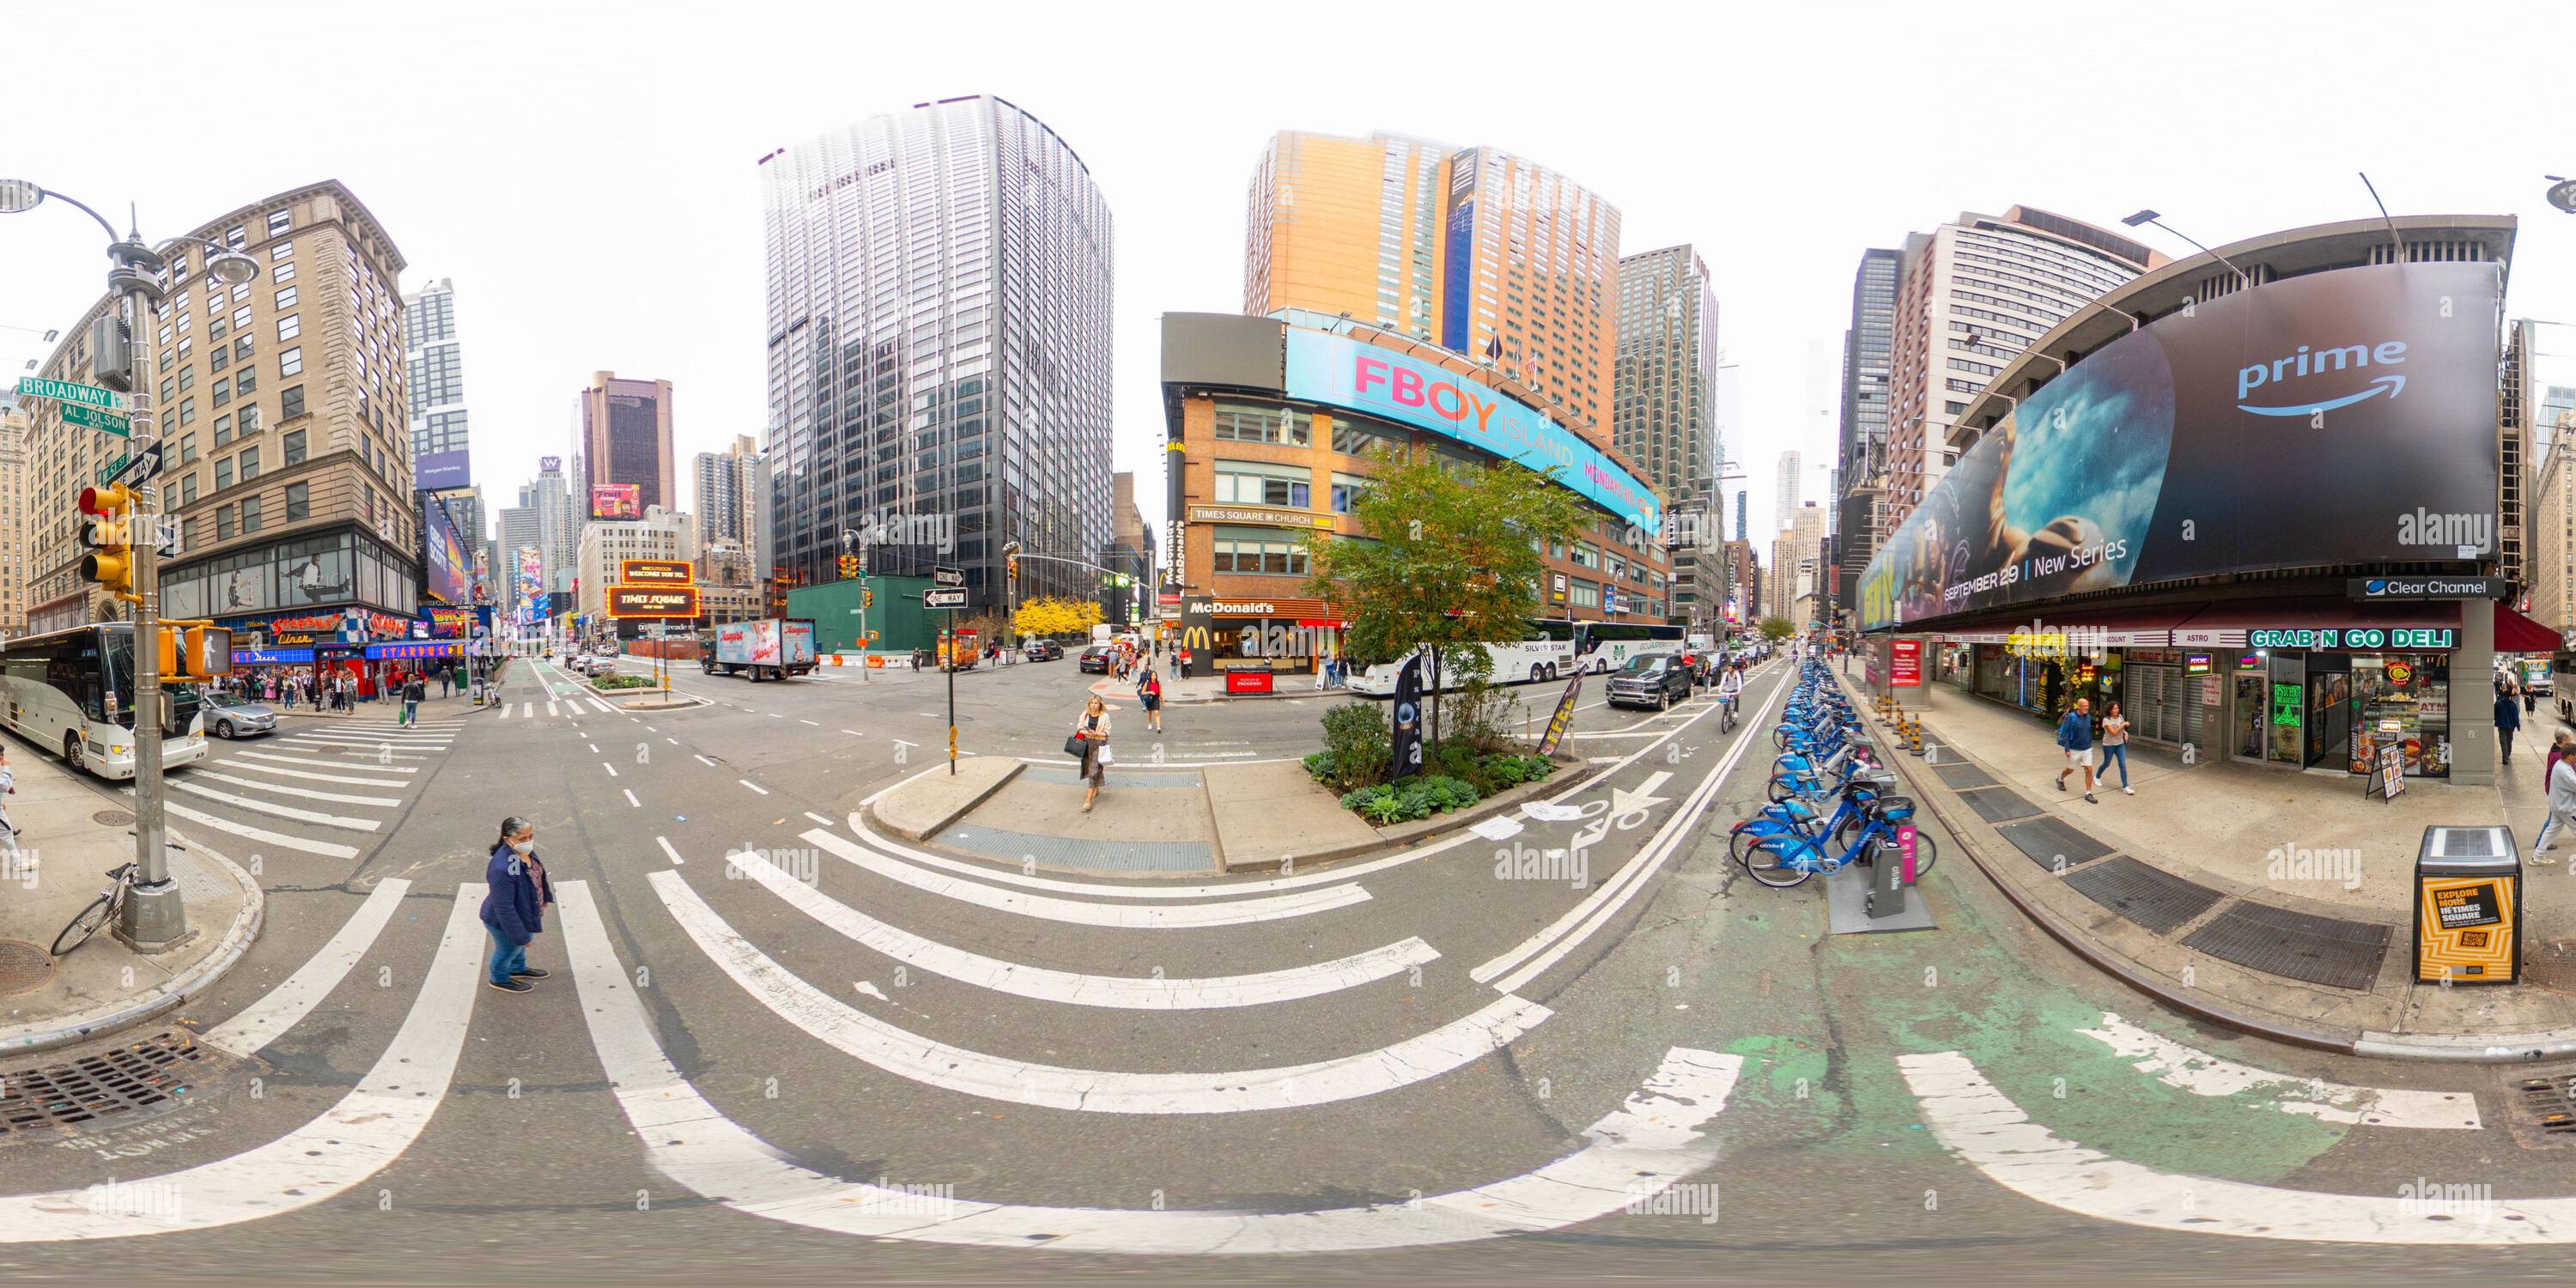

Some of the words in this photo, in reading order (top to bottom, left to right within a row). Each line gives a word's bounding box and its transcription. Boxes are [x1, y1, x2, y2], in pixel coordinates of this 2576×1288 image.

[2238, 341, 2407, 399] prime
[23, 378, 106, 405] BROADWAY
[64, 405, 80, 418] AL
[83, 410, 125, 429] JOLSON
[1355, 355, 1498, 433] FBOY
[1502, 416, 1574, 467] ISLAND
[109, 464, 117, 476] 51
[118, 455, 125, 467] ST
[134, 454, 153, 478] WAY
[543, 459, 558, 469] W
[1584, 460, 1622, 498] MONDAYS
[1195, 510, 1225, 519] TIMES
[1227, 512, 1264, 520] SQUARE
[1274, 514, 1310, 525] CHURCH
[1176, 520, 1184, 586] McDonald's
[1944, 572, 1997, 601] SEPTEMBER
[2000, 565, 2019, 586] 29
[2034, 555, 2066, 578] New
[2070, 538, 2127, 568] Series
[2387, 581, 2425, 594] Clear
[2428, 580, 2487, 594] Channel
[621, 594, 649, 604] TIMES
[649, 595, 686, 605] SQUARE
[1190, 603, 1274, 614] McDonald's
[271, 613, 343, 635] STARDUST
[2251, 630, 2314, 647] GRAB
[2346, 629, 2385, 647] GO
[2392, 629, 2452, 647] DELI
[2277, 687, 2299, 696] PSYCHIC
[2420, 702, 2446, 711] ATM
[2437, 889, 2479, 899] EXPLORE
[2439, 898, 2466, 907] MORE
[2452, 904, 2481, 913] TIMES
[2442, 912, 2481, 921] SQUARE
